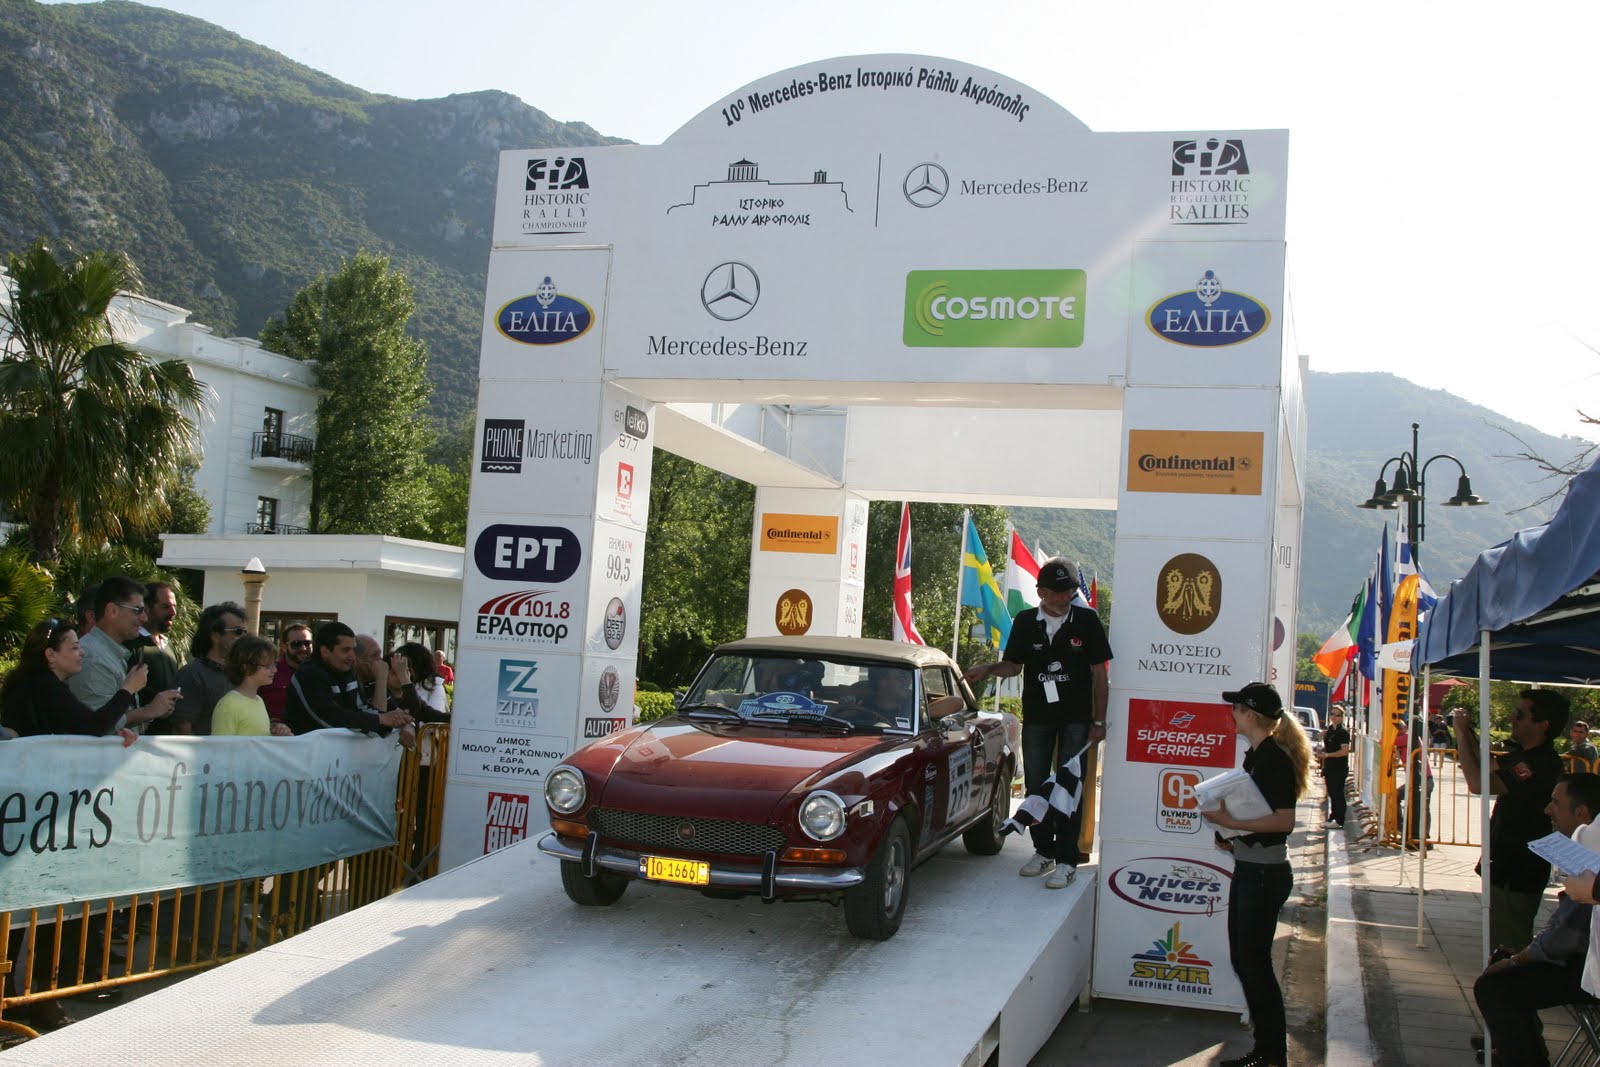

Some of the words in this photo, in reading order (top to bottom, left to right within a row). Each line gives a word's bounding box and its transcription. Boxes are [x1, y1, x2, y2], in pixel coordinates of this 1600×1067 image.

[748, 72, 852, 114] Mercedes-Benz
[857, 66, 913, 91] Ιστορικό
[917, 67, 960, 94] Ράλλυ
[960, 76, 1030, 123] Ακρόπολις
[959, 177, 1089, 196] Mercedes-Benz
[1171, 179, 1250, 193] HISTORIC
[524, 192, 590, 206] HISTORIC
[739, 198, 785, 211] ΙΣΤΟΡΙΚΟ
[1170, 194, 1249, 203] REGULARITY
[523, 207, 588, 219] RALLY
[751, 213, 811, 226] ΑΚΡΟΠΟΛΙΣ
[1169, 203, 1250, 220] RALLIES
[521, 221, 588, 230] CHAMPIONSHIP
[930, 295, 1077, 322] COSMOTE
[507, 310, 580, 333] ΕΛΠΑ
[1163, 308, 1253, 335] ΕΛΠΑ
[646, 336, 808, 358] Mercedes-Benz
[627, 409, 647, 434] lefko
[484, 427, 523, 459] PHONE
[526, 428, 593, 465] Marketing
[1138, 453, 1236, 473] Continental
[766, 527, 823, 540] Continental
[606, 553, 631, 587] 99,5
[524, 600, 570, 619] 101.8
[1150, 642, 1221, 659] ΜΟΥΣΕΙΟ
[1138, 659, 1232, 676] ΝΑΣΙΟΥΤΖΙΚ
[498, 700, 537, 717] ZITA
[494, 716, 538, 727] CONGRESS
[496, 736, 531, 747] ΔΗΜΟΣ
[1137, 729, 1227, 746] SUPERFAST
[462, 743, 498, 754] ΜΩΛΟΥ
[504, 748, 565, 760] ΑΓ.ΚΩΝ/ΝΟΥ
[1146, 743, 1211, 758] FERRIES
[499, 756, 525, 765] ΕΔΡΑ
[482, 764, 541, 777] Κ.ΒΟΥΡΛΑ
[0, 785, 115, 857] ears
[136, 760, 188, 845] of
[195, 758, 363, 838] innovation
[486, 795, 528, 828] Auto
[1161, 809, 1198, 819] OLYMPUS
[1165, 817, 1192, 826] PLAZA
[1127, 870, 1222, 893] Drivers
[1129, 961, 1212, 986] STAR
[1128, 978, 1173, 991] ΚΕΝΤΡΙΚΗΣ
[1176, 984, 1213, 996] ΕΛΛΑΔΑΣ
